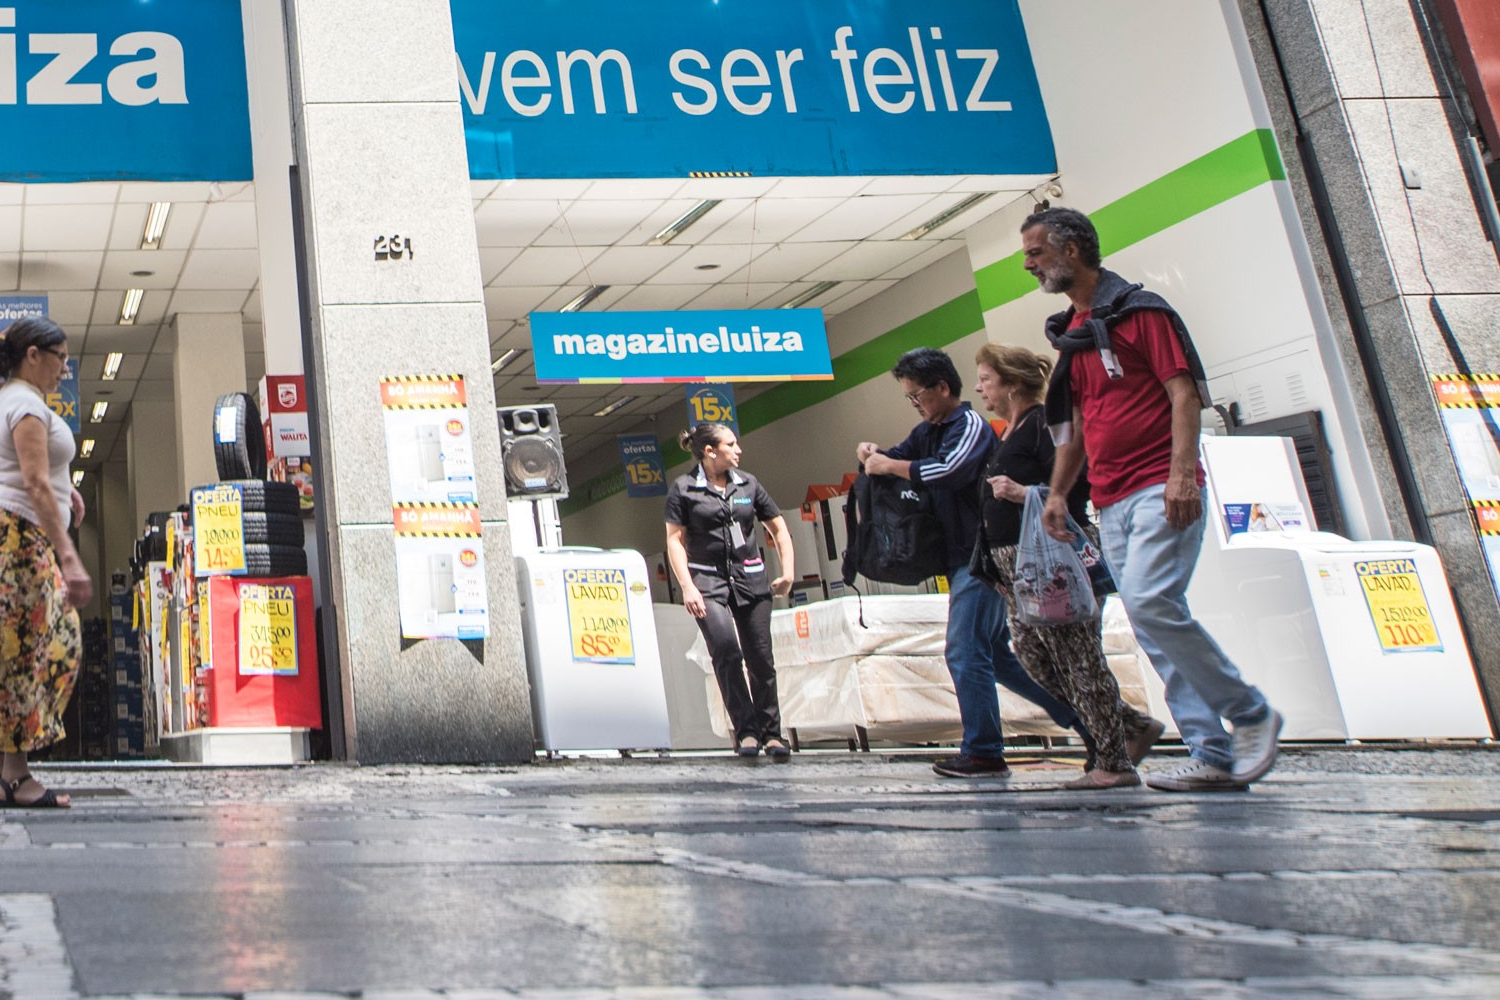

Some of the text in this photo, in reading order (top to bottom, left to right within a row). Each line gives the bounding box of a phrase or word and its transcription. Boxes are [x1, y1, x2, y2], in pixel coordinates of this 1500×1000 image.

[457, 25, 1013, 117] vem ser feliz
[8, 302, 43, 310] melhores
[552, 325, 805, 361] magazineluiza
[387, 381, 459, 397] SÓ AMANHÃ
[1440, 382, 1500, 395] SÓ AMANH
[43, 393, 76, 417] 5x
[689, 397, 734, 422] 15x
[280, 433, 308, 442] WALITA
[623, 444, 657, 455] ofertas
[626, 463, 663, 484] 15x
[193, 488, 242, 504] OFERTA
[197, 504, 238, 519] PNEU
[401, 509, 474, 523] SÓ AMANHÃ
[1482, 508, 1498, 521] SÓ
[1356, 559, 1417, 576] OFERTA
[565, 569, 625, 583] OFERTA
[240, 584, 294, 600] OFERTA
[243, 600, 290, 617] PNEU
